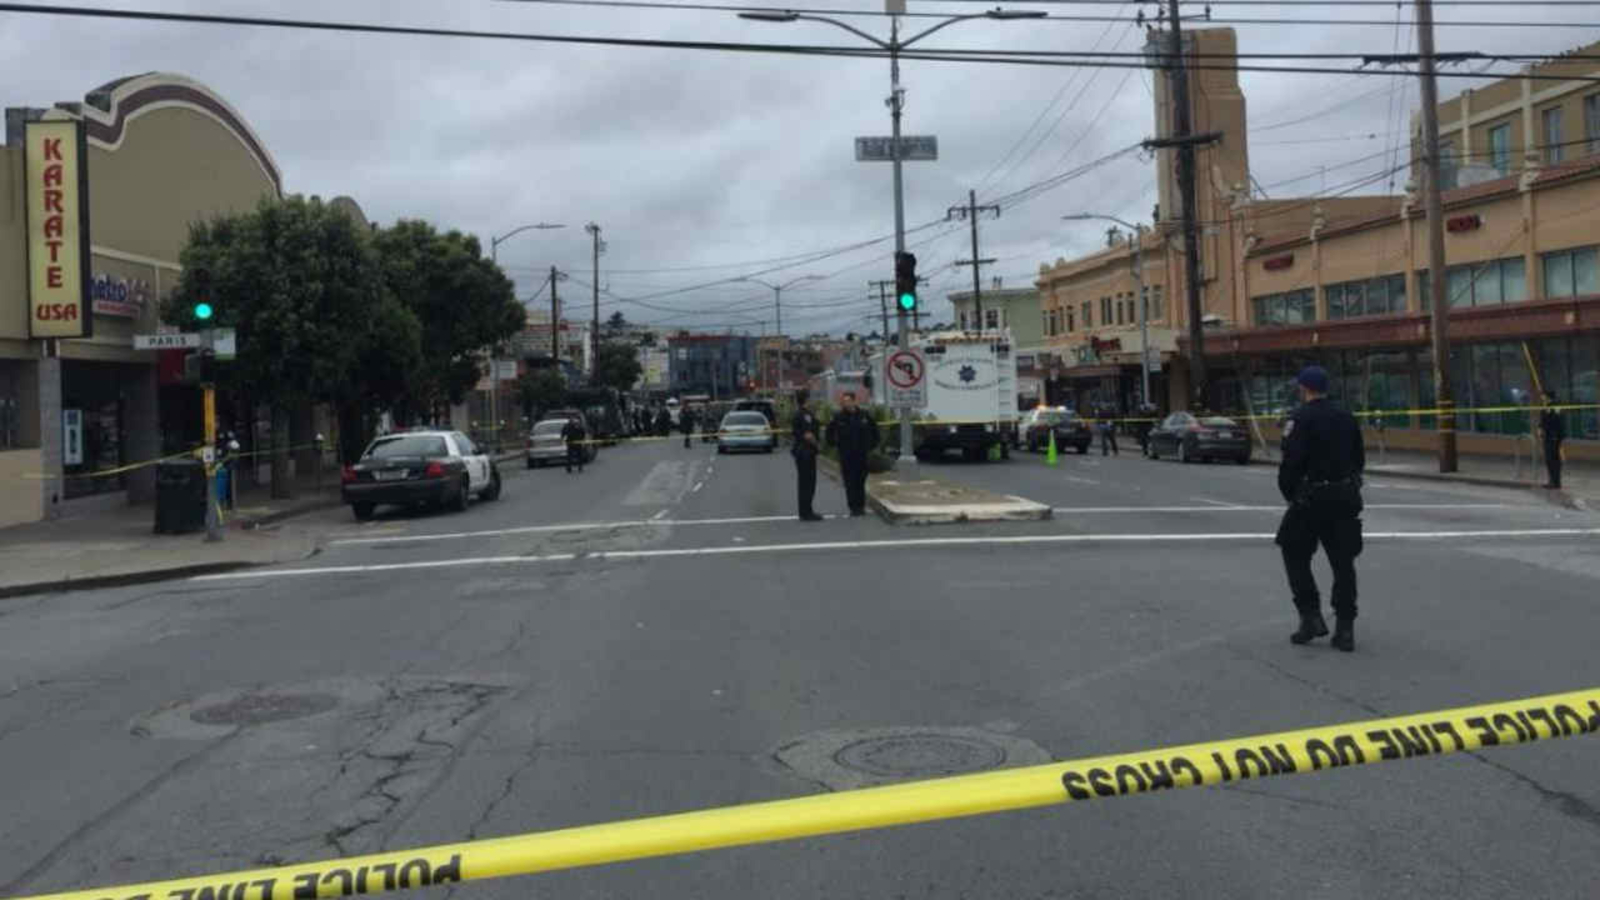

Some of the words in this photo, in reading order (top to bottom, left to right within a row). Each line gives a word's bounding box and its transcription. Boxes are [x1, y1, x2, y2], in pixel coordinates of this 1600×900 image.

[43, 138, 64, 288] KARATE
[36, 303, 77, 321] USA
[149, 336, 187, 347] PARIS
[1305, 735, 1365, 770] DO
[1366, 722, 1465, 760] LINE
[1062, 756, 1202, 800] CROSS
[294, 854, 461, 900] POLICE
